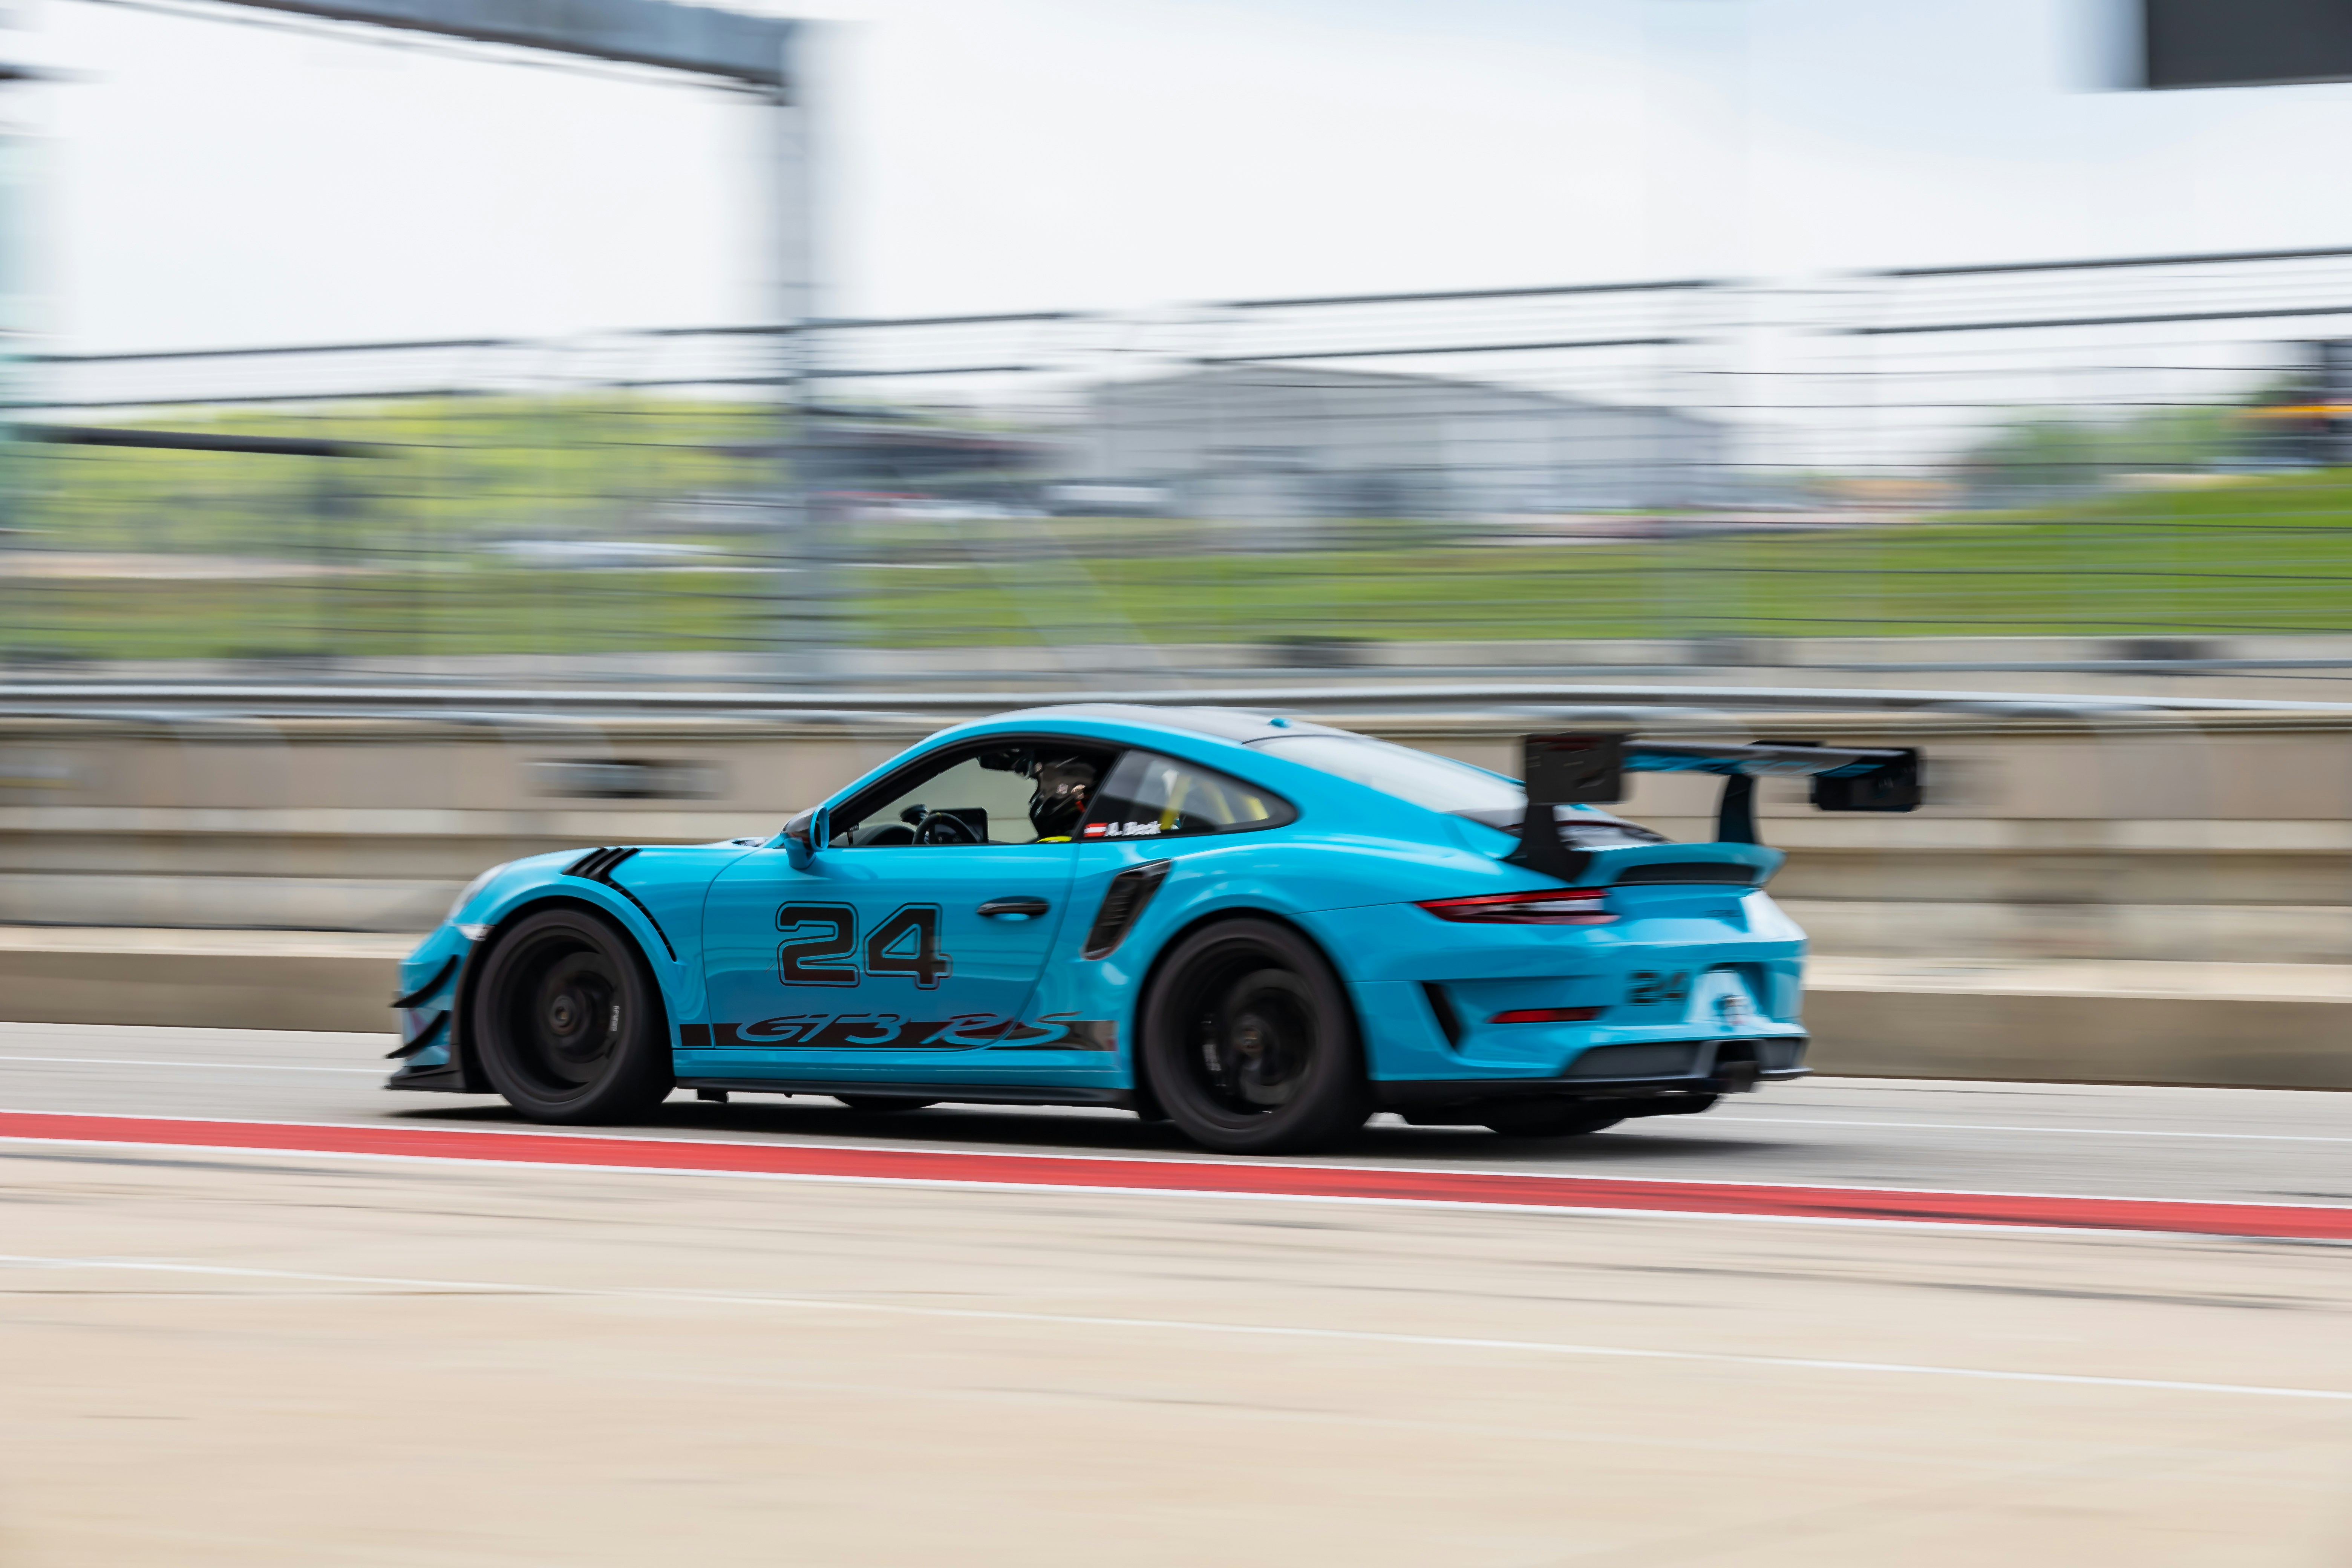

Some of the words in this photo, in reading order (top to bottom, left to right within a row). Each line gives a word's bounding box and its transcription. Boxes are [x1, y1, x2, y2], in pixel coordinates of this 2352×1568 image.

[775, 900, 954, 990] 24
[1625, 969, 1690, 1007] 24
[736, 1013, 903, 1044] GT3
[919, 1011, 1083, 1047] RS
